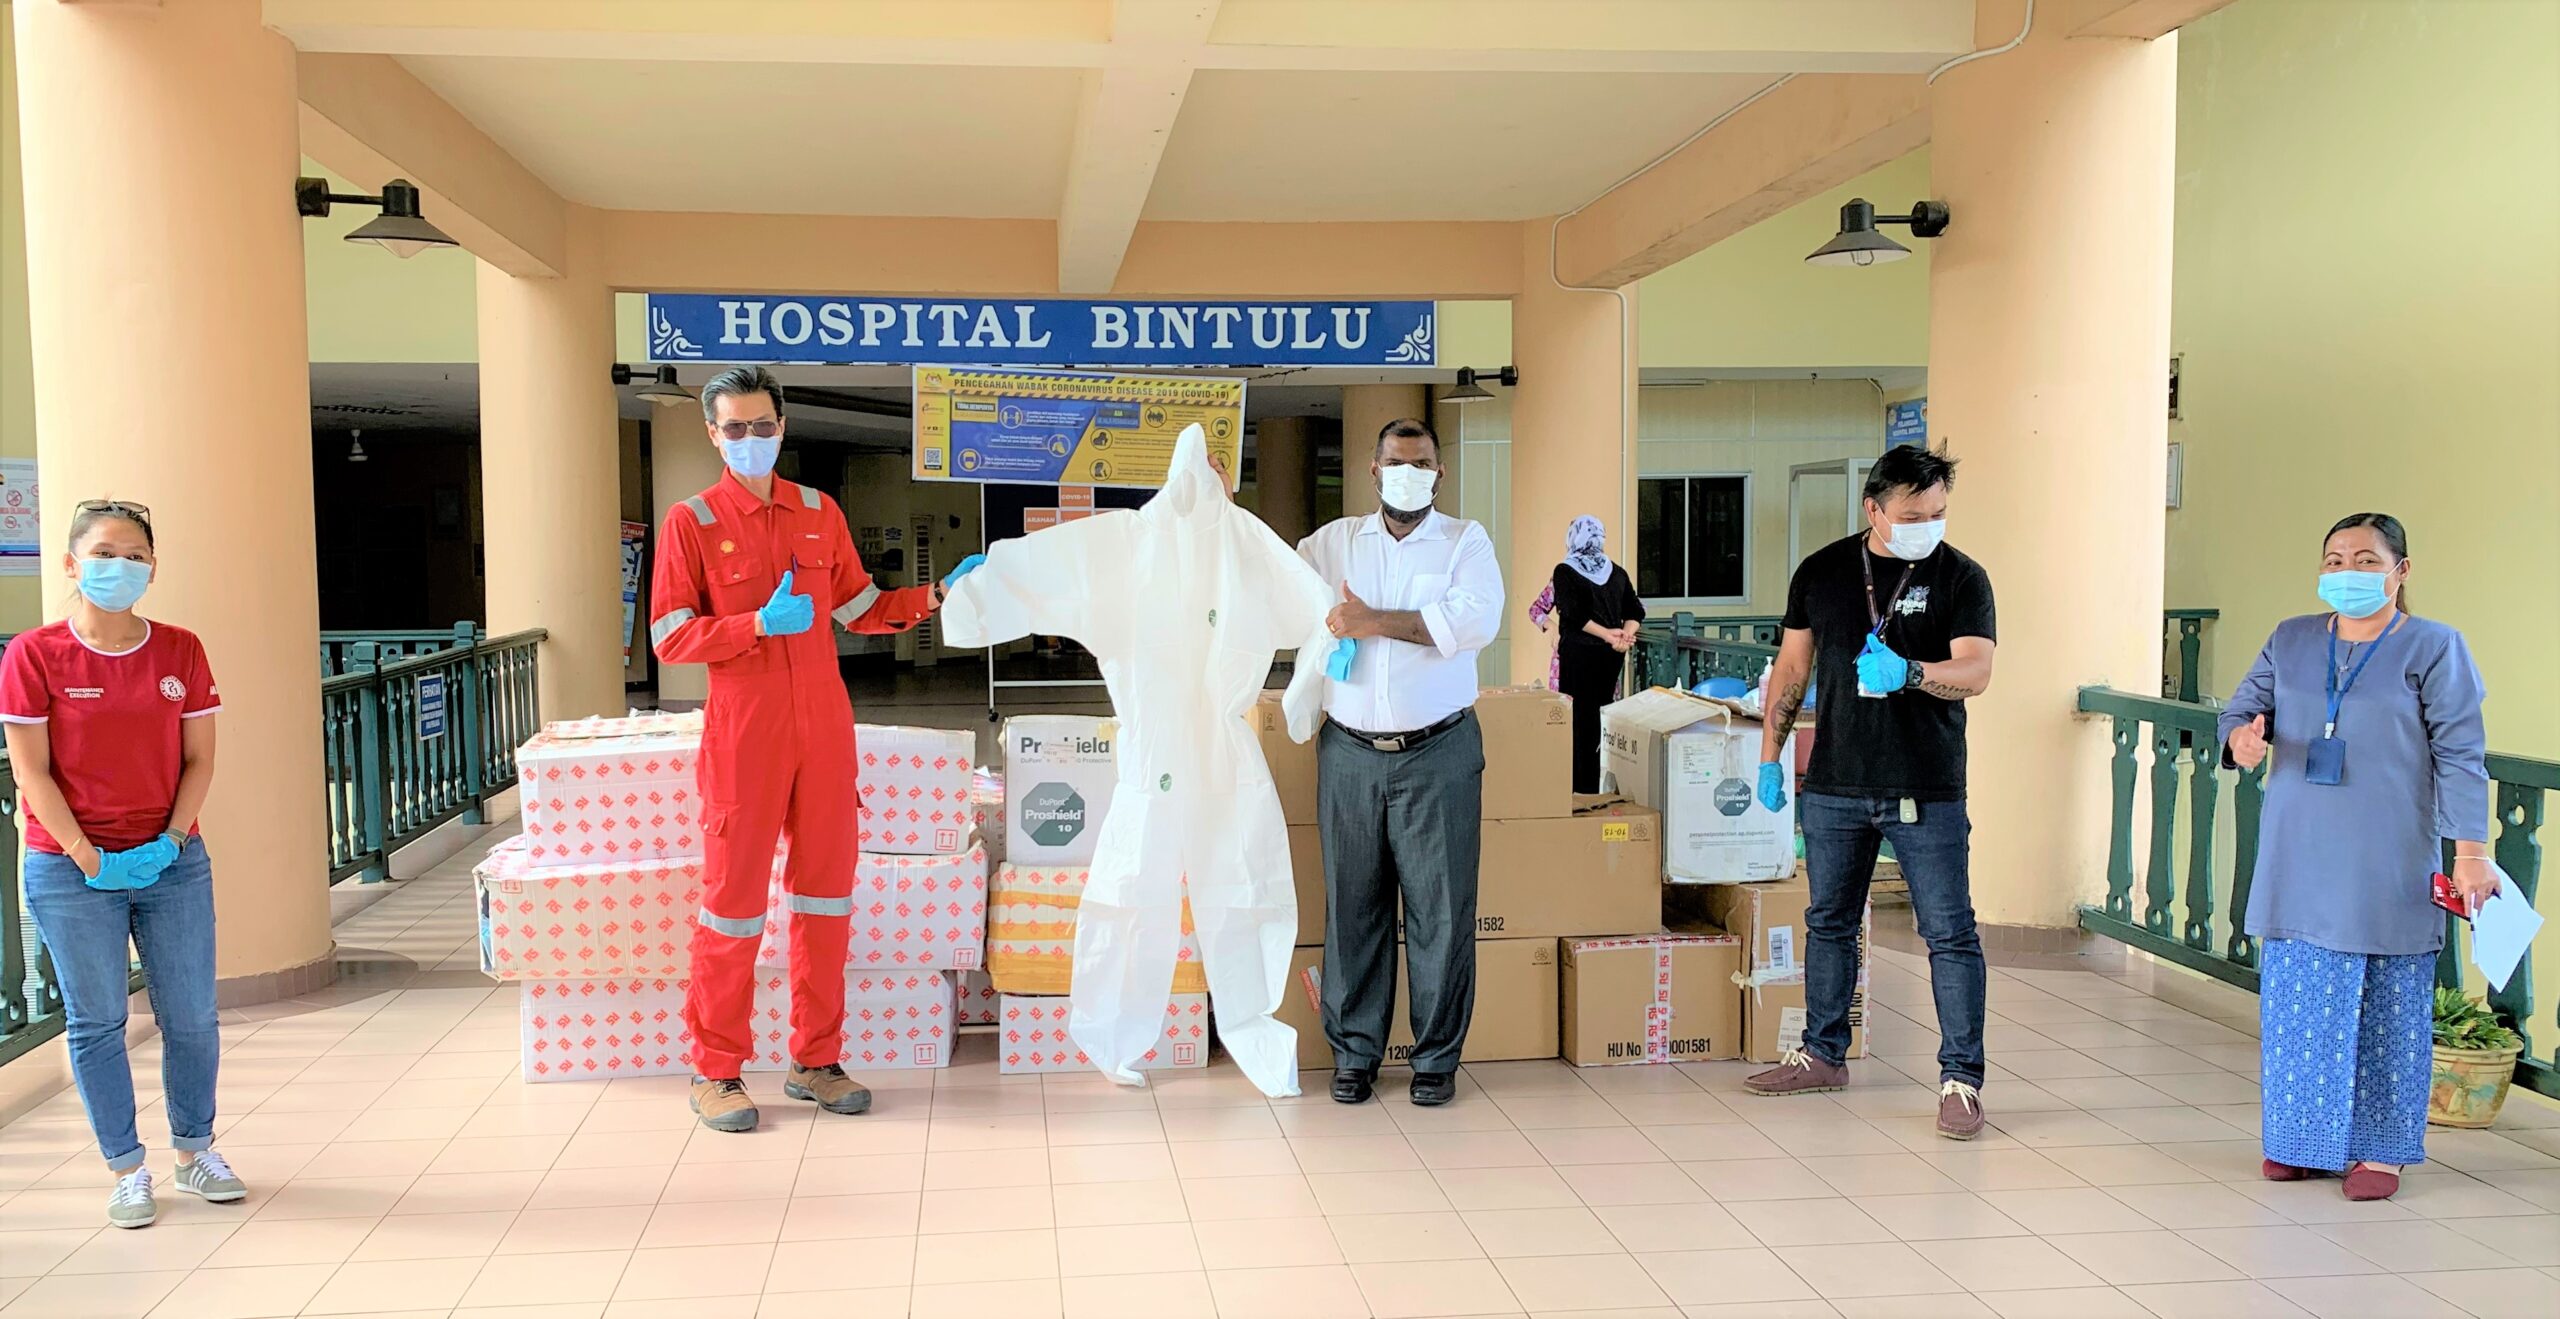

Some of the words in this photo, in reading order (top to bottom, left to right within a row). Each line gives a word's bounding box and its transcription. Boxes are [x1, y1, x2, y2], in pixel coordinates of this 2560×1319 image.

[718, 301, 1052, 348] HOSPITAL
[1091, 306, 1373, 350] BINTULU
[954, 379, 1014, 391] PENCEGAHAN
[1016, 381, 1049, 392] WABAK
[1051, 383, 1114, 394] CORONAVIRUS
[1116, 385, 1153, 396] DISEASE
[1156, 387, 1179, 398] 2019
[1181, 388, 1230, 399] (COVID-19)
[1020, 736, 1110, 754] Prield
[1040, 798, 1066, 806] DuPont
[1716, 793, 1751, 801] Proshield
[1025, 809, 1084, 821] Proshield
[1608, 1043, 1624, 1058] HU
[1626, 1043, 1641, 1057] No
